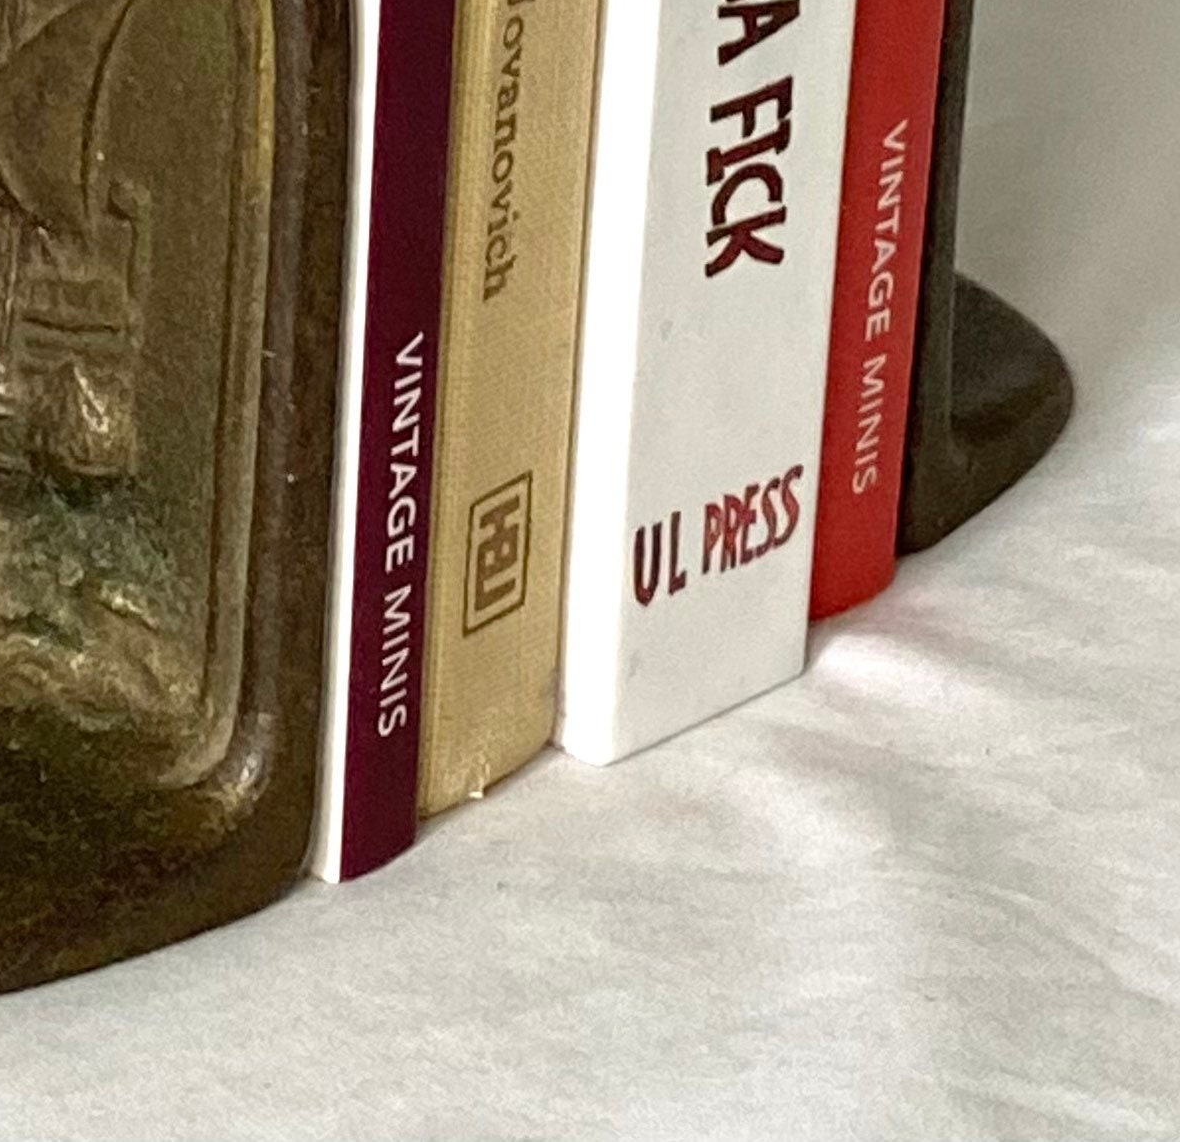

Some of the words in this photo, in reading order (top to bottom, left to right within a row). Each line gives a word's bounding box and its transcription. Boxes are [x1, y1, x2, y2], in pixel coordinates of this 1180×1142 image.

[704, 74, 794, 279] FICK
[864, 119, 909, 342] VINTAGE
[385, 331, 424, 574] VINTAGE
[852, 353, 887, 496] MINIS
[633, 510, 688, 608] UL
[701, 463, 805, 576] PRESS
[377, 583, 412, 738] MINIS
